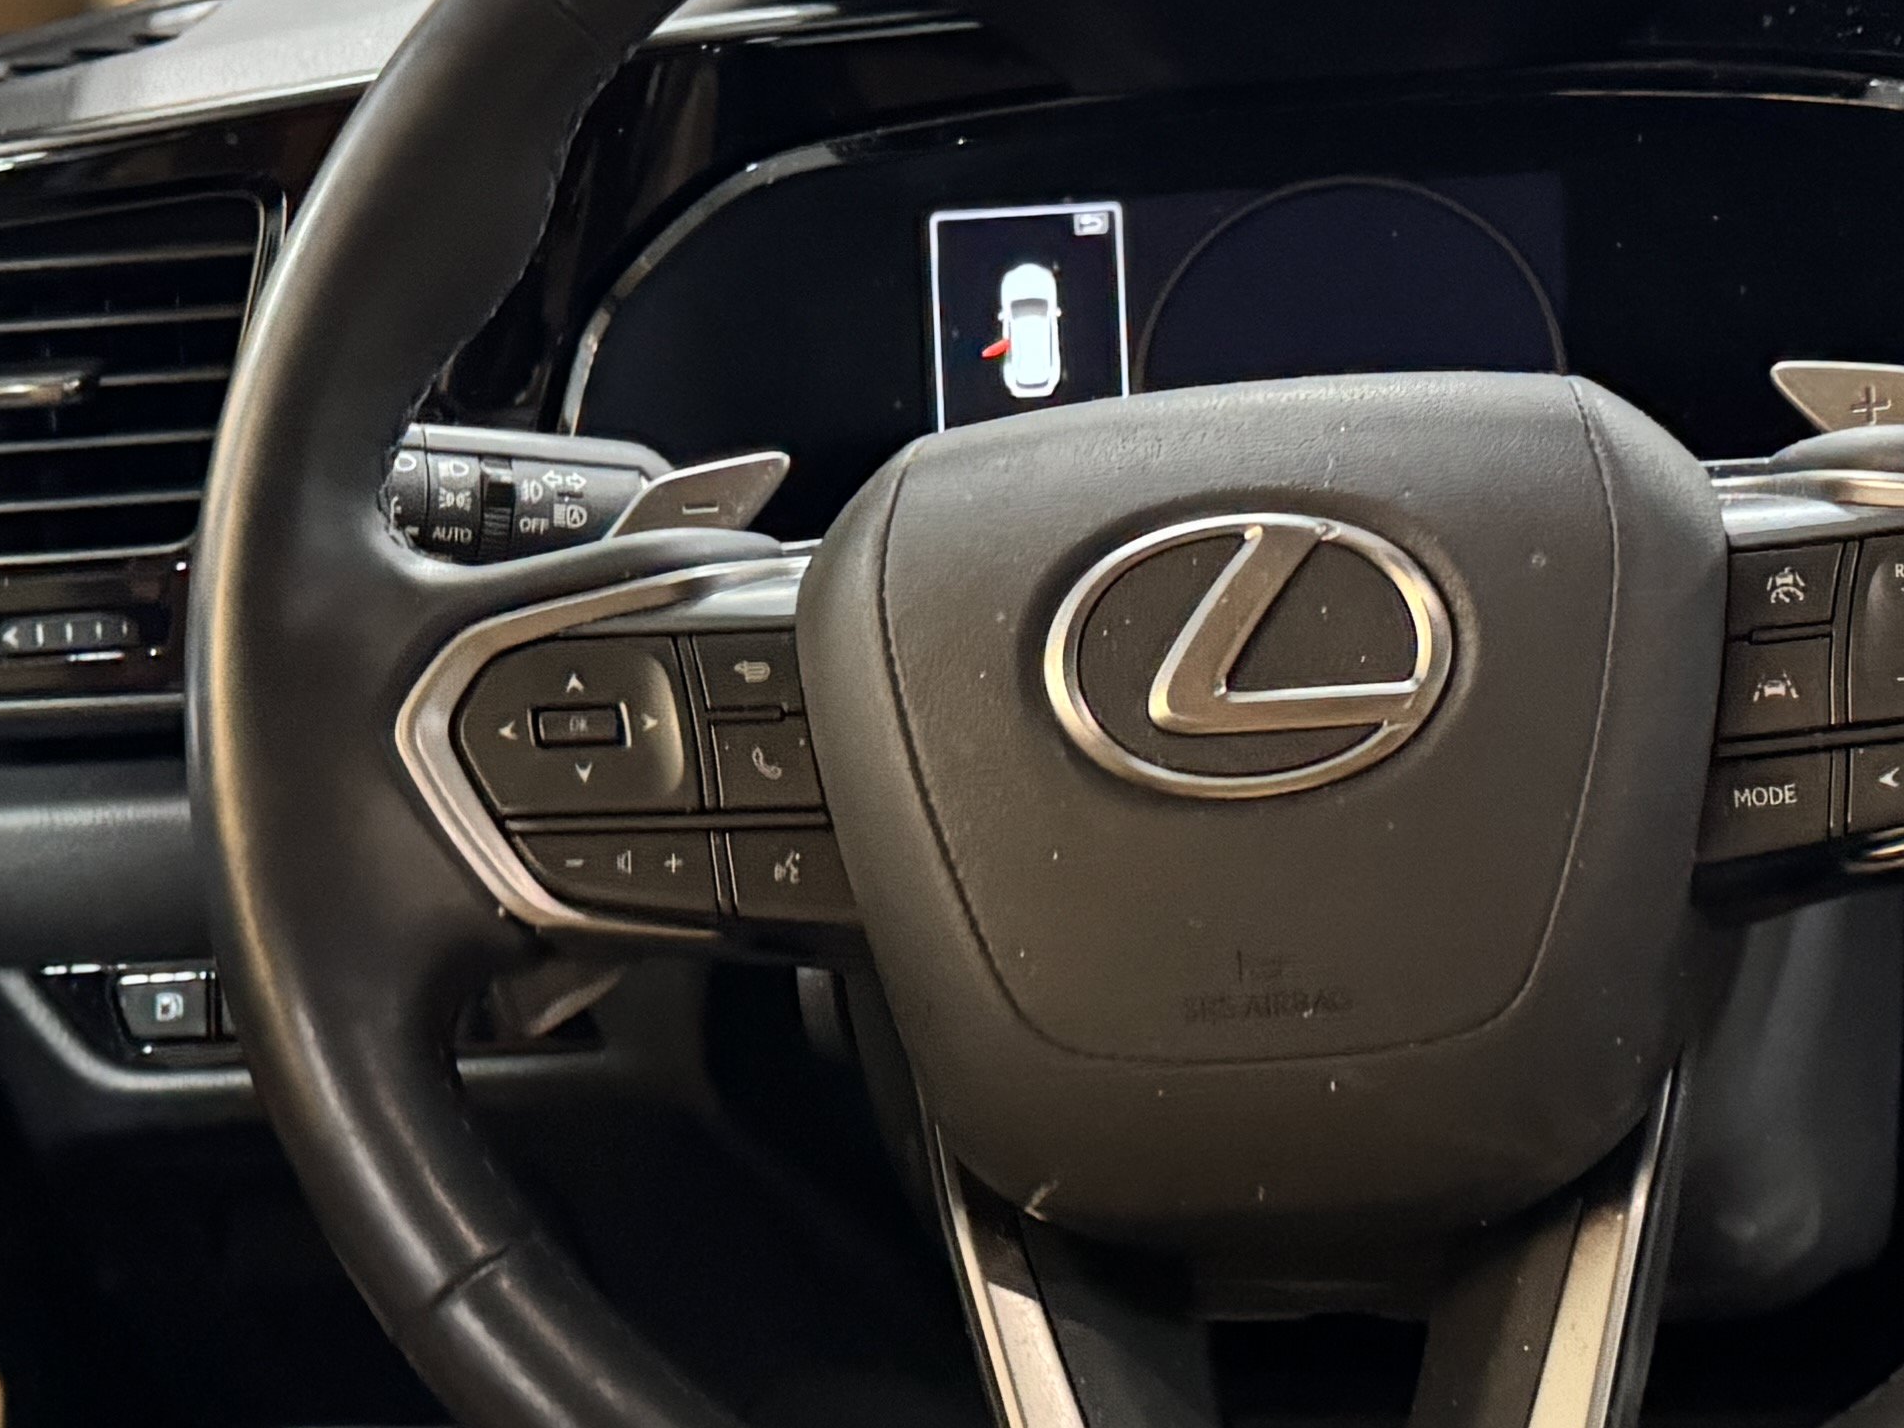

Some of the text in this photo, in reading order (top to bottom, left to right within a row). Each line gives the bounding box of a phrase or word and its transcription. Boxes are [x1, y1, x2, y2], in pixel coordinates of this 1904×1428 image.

[431, 525, 473, 545] AUTO
[519, 517, 549, 534] OFF
[568, 716, 590, 734] OK
[1733, 782, 1798, 809] MODE
